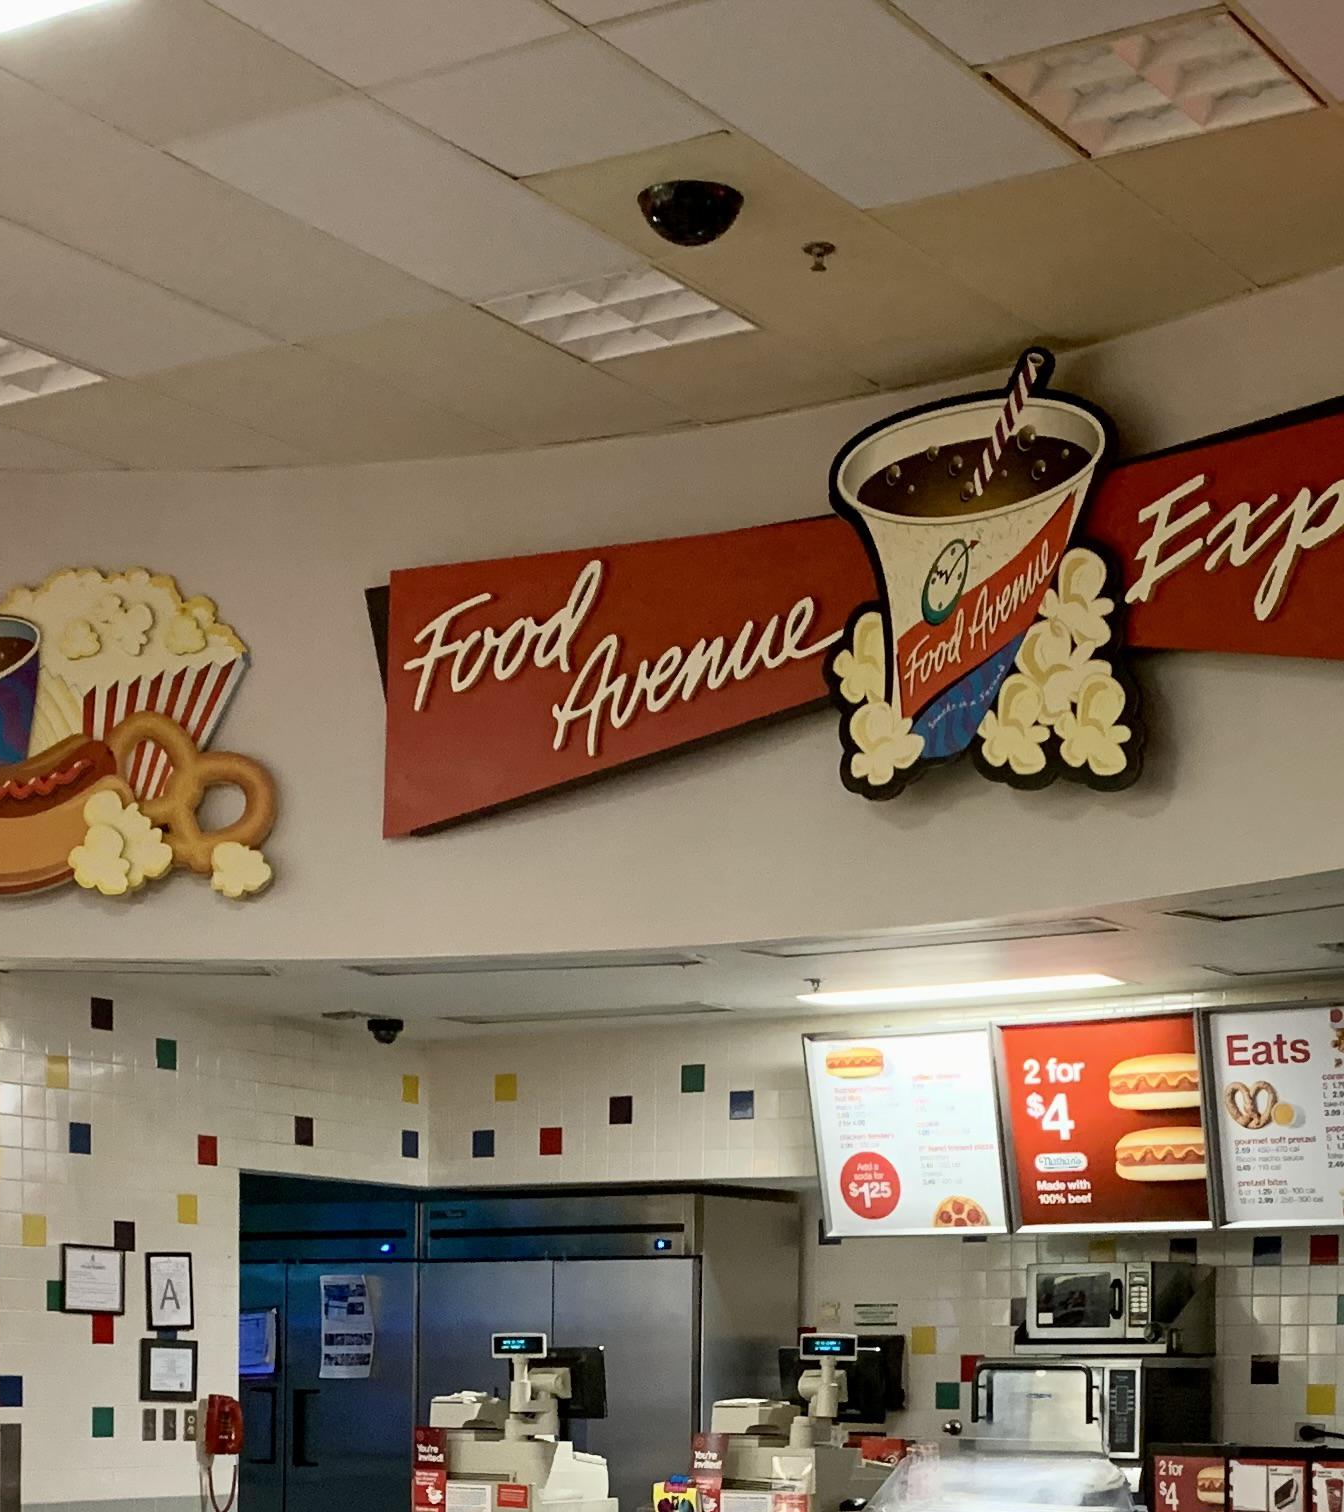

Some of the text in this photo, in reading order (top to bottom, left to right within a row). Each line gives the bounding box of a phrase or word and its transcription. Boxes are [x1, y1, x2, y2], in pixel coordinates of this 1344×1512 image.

[904, 538, 1059, 697] Food Avenue
[404, 560, 602, 711] Food
[553, 597, 843, 756] Avenue
[1226, 1034, 1311, 1066] Eats
[1024, 1058, 1085, 1085] 2 for
[1026, 1092, 1075, 1140] $4
[1036, 1179, 1091, 1191] Made with
[1038, 1193, 1092, 1205] 100% beef
[160, 1278, 181, 1310] A
[416, 1444, 439, 1454] You're
[694, 1450, 718, 1461] You're
[1159, 1460, 1184, 1477] 2 for
[1160, 1481, 1179, 1511] $4
